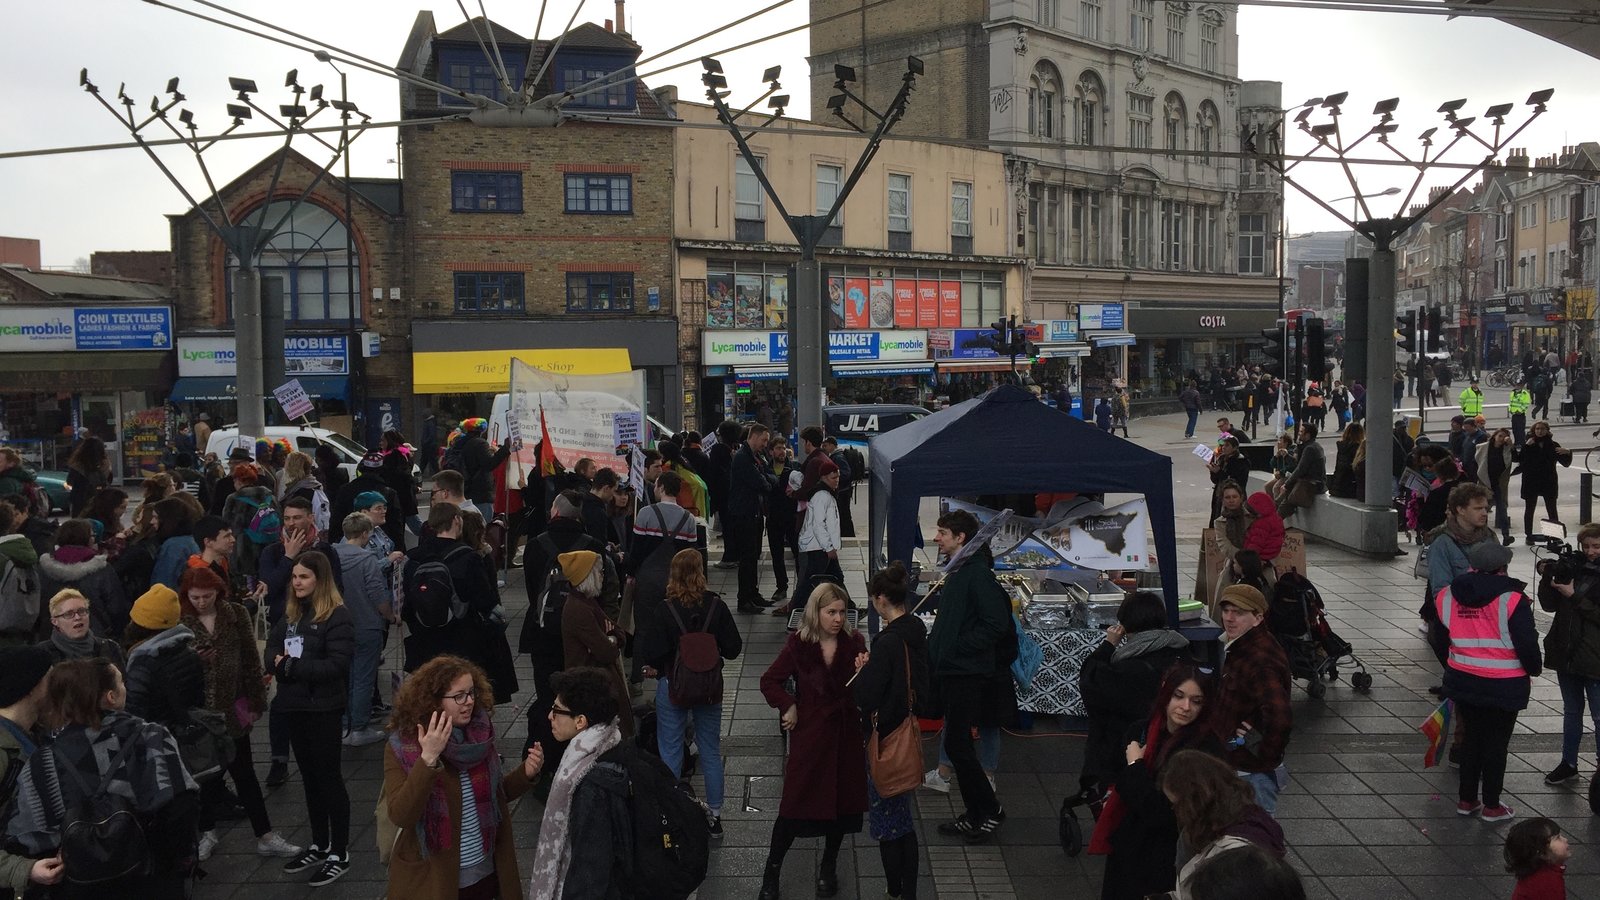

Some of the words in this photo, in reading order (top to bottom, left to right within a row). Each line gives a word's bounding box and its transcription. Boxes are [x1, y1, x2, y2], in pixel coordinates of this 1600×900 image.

[78, 313, 109, 324] CIONI
[112, 313, 165, 323] TEXTILES
[1200, 315, 1226, 328] COSTA
[284, 338, 342, 352] MOBILE
[712, 341, 767, 354] Lycamobile
[880, 339, 923, 351] Lycamobile
[474, 363, 496, 374] The
[546, 361, 575, 373] Shop
[839, 413, 879, 432] JLA
